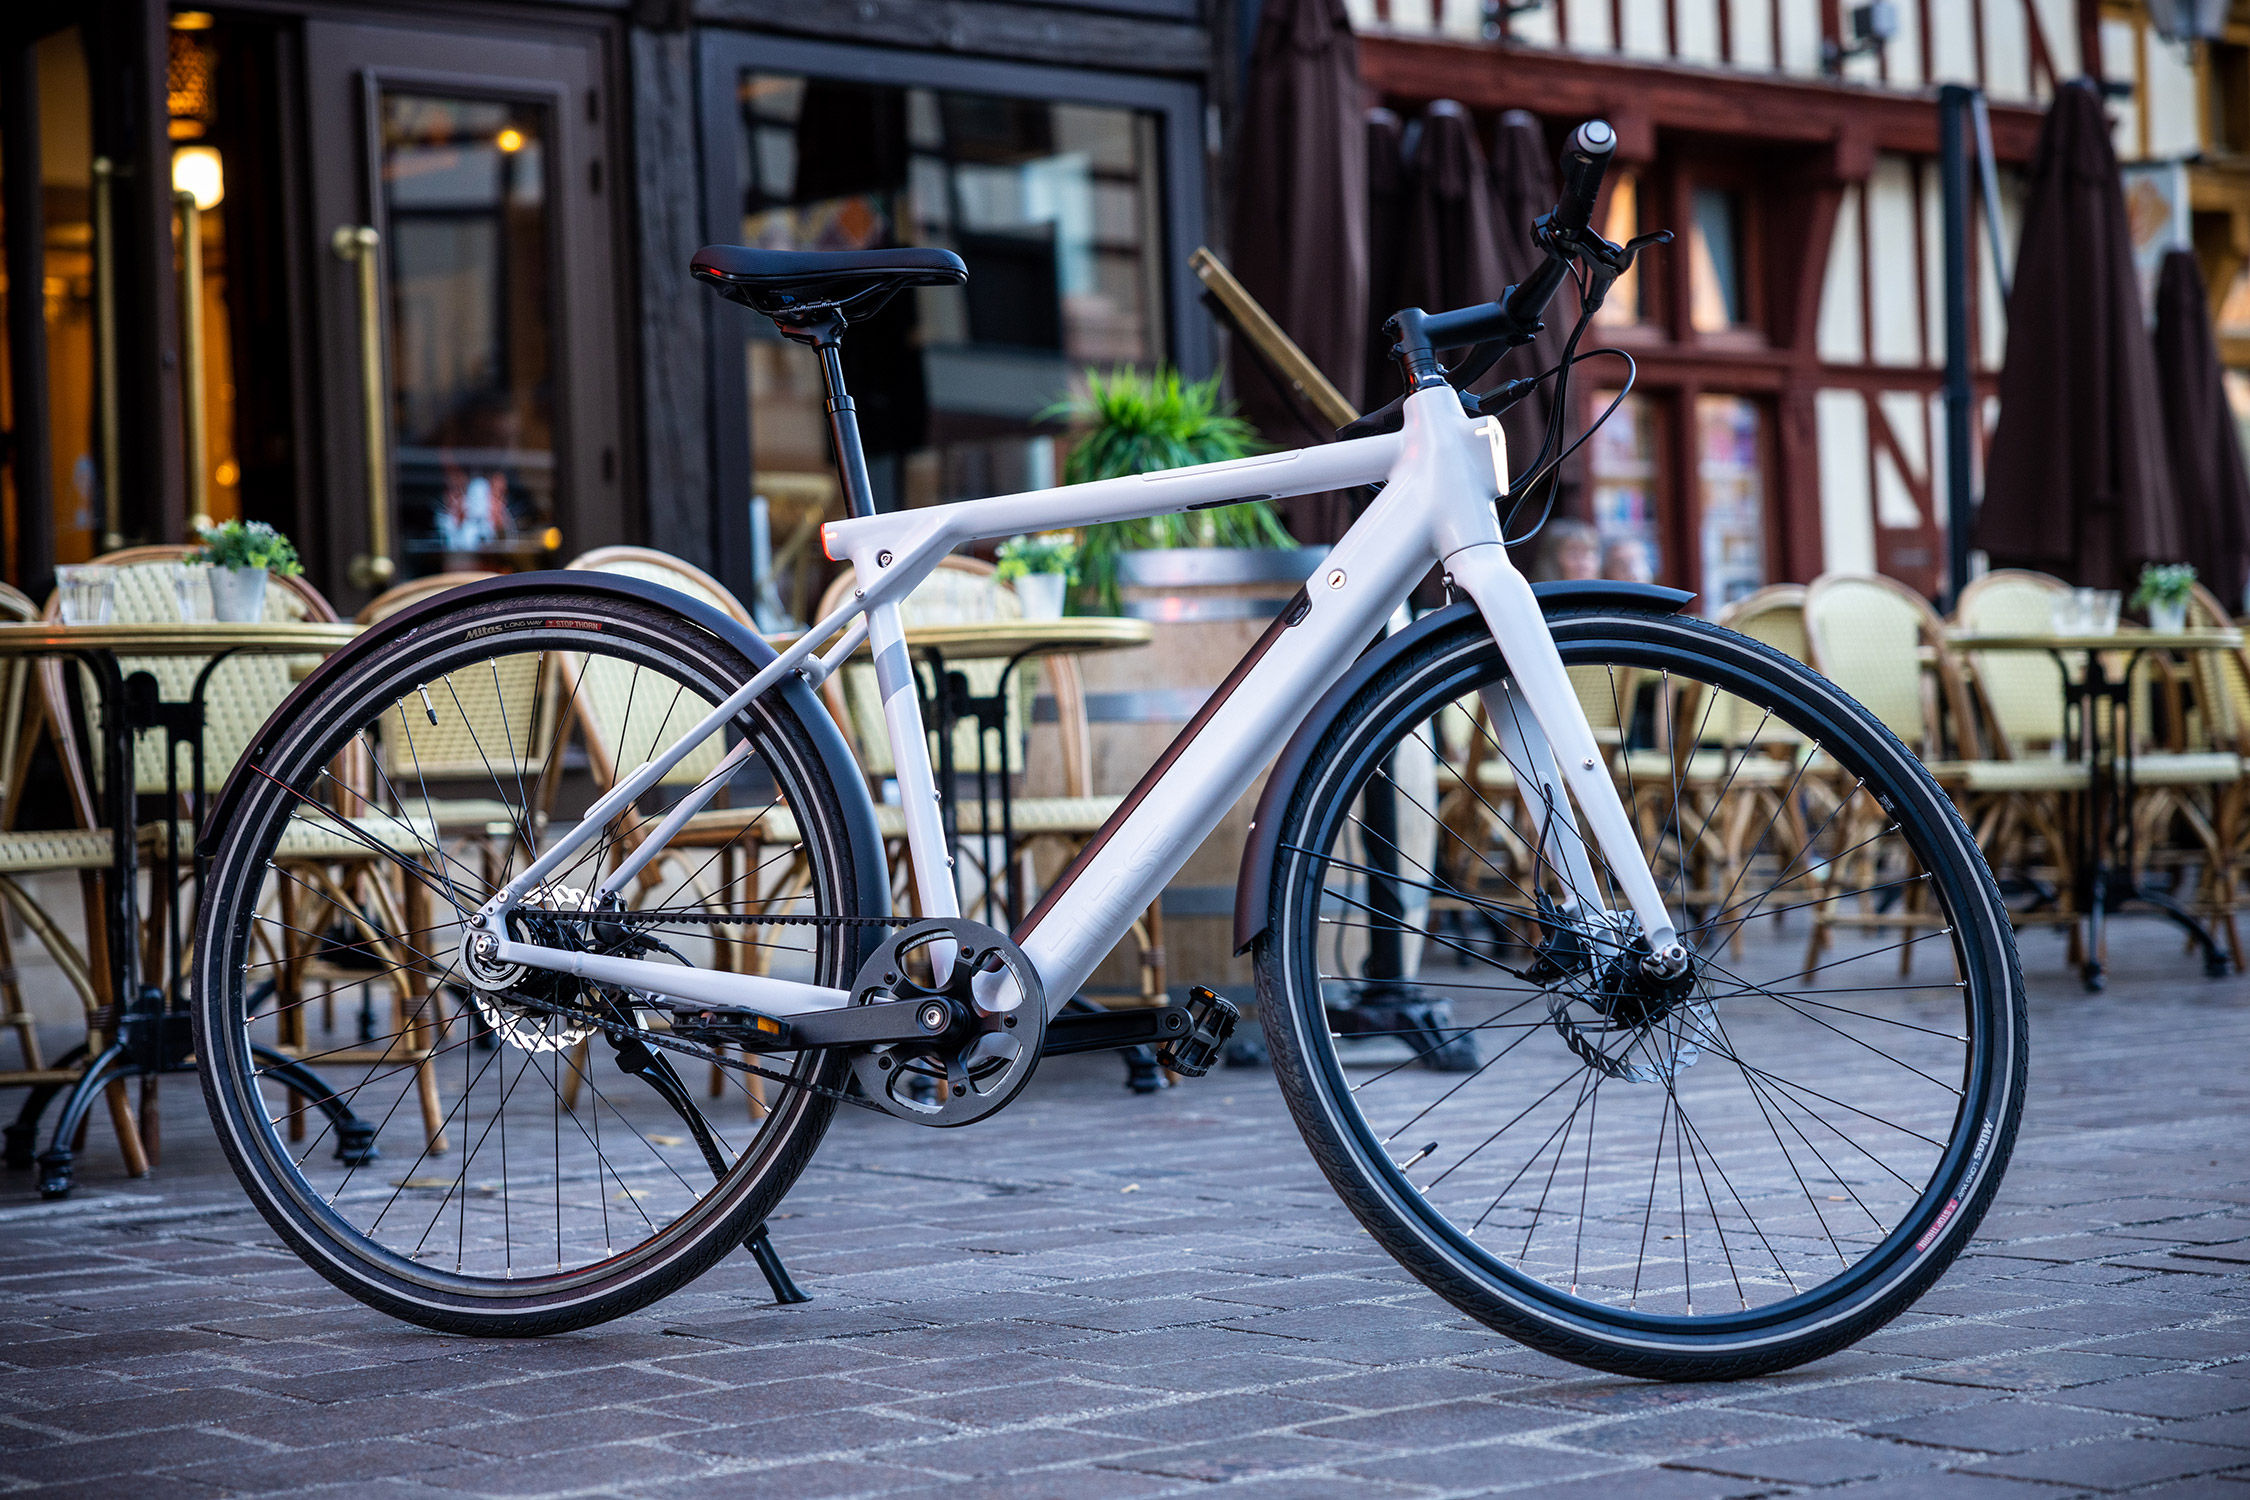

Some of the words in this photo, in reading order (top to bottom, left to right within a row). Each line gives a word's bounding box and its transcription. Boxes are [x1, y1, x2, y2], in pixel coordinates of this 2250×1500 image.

[464, 623, 503, 641] Mitas
[504, 620, 526, 629] LONG
[526, 619, 544, 627] WAY
[556, 620, 574, 629] STOP
[574, 621, 599, 630] THORN
[1973, 1117, 1994, 1160] Mitas
[1966, 1162, 1980, 1183] LONG
[1957, 1183, 1970, 1200] WAY
[1937, 1210, 1951, 1228] STOP
[1918, 1226, 1940, 1250] THORN
